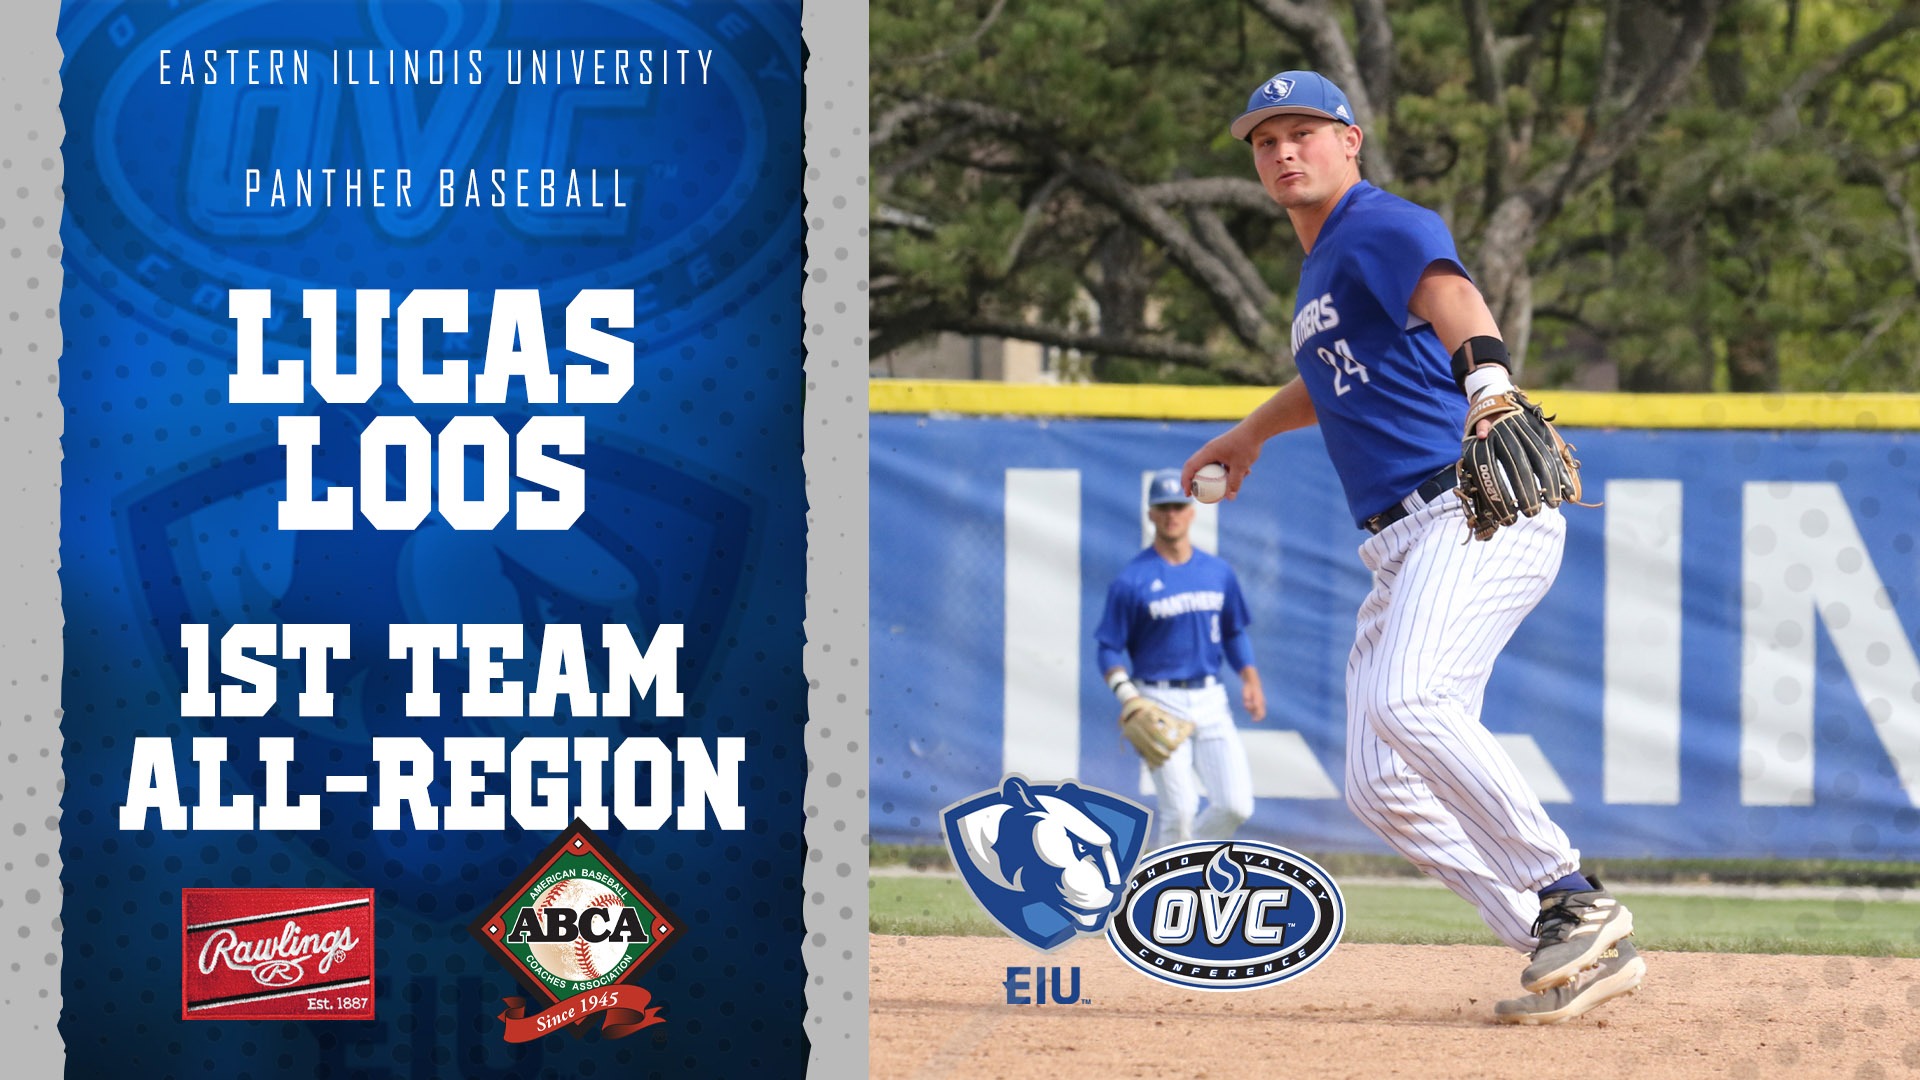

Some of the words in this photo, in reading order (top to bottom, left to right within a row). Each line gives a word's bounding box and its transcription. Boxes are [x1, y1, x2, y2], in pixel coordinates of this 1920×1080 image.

[1291, 293, 1340, 358] NTHERS
[1317, 338, 1370, 396] 24
[1479, 464, 1502, 502] A2000
[1003, 467, 1920, 807] IIN
